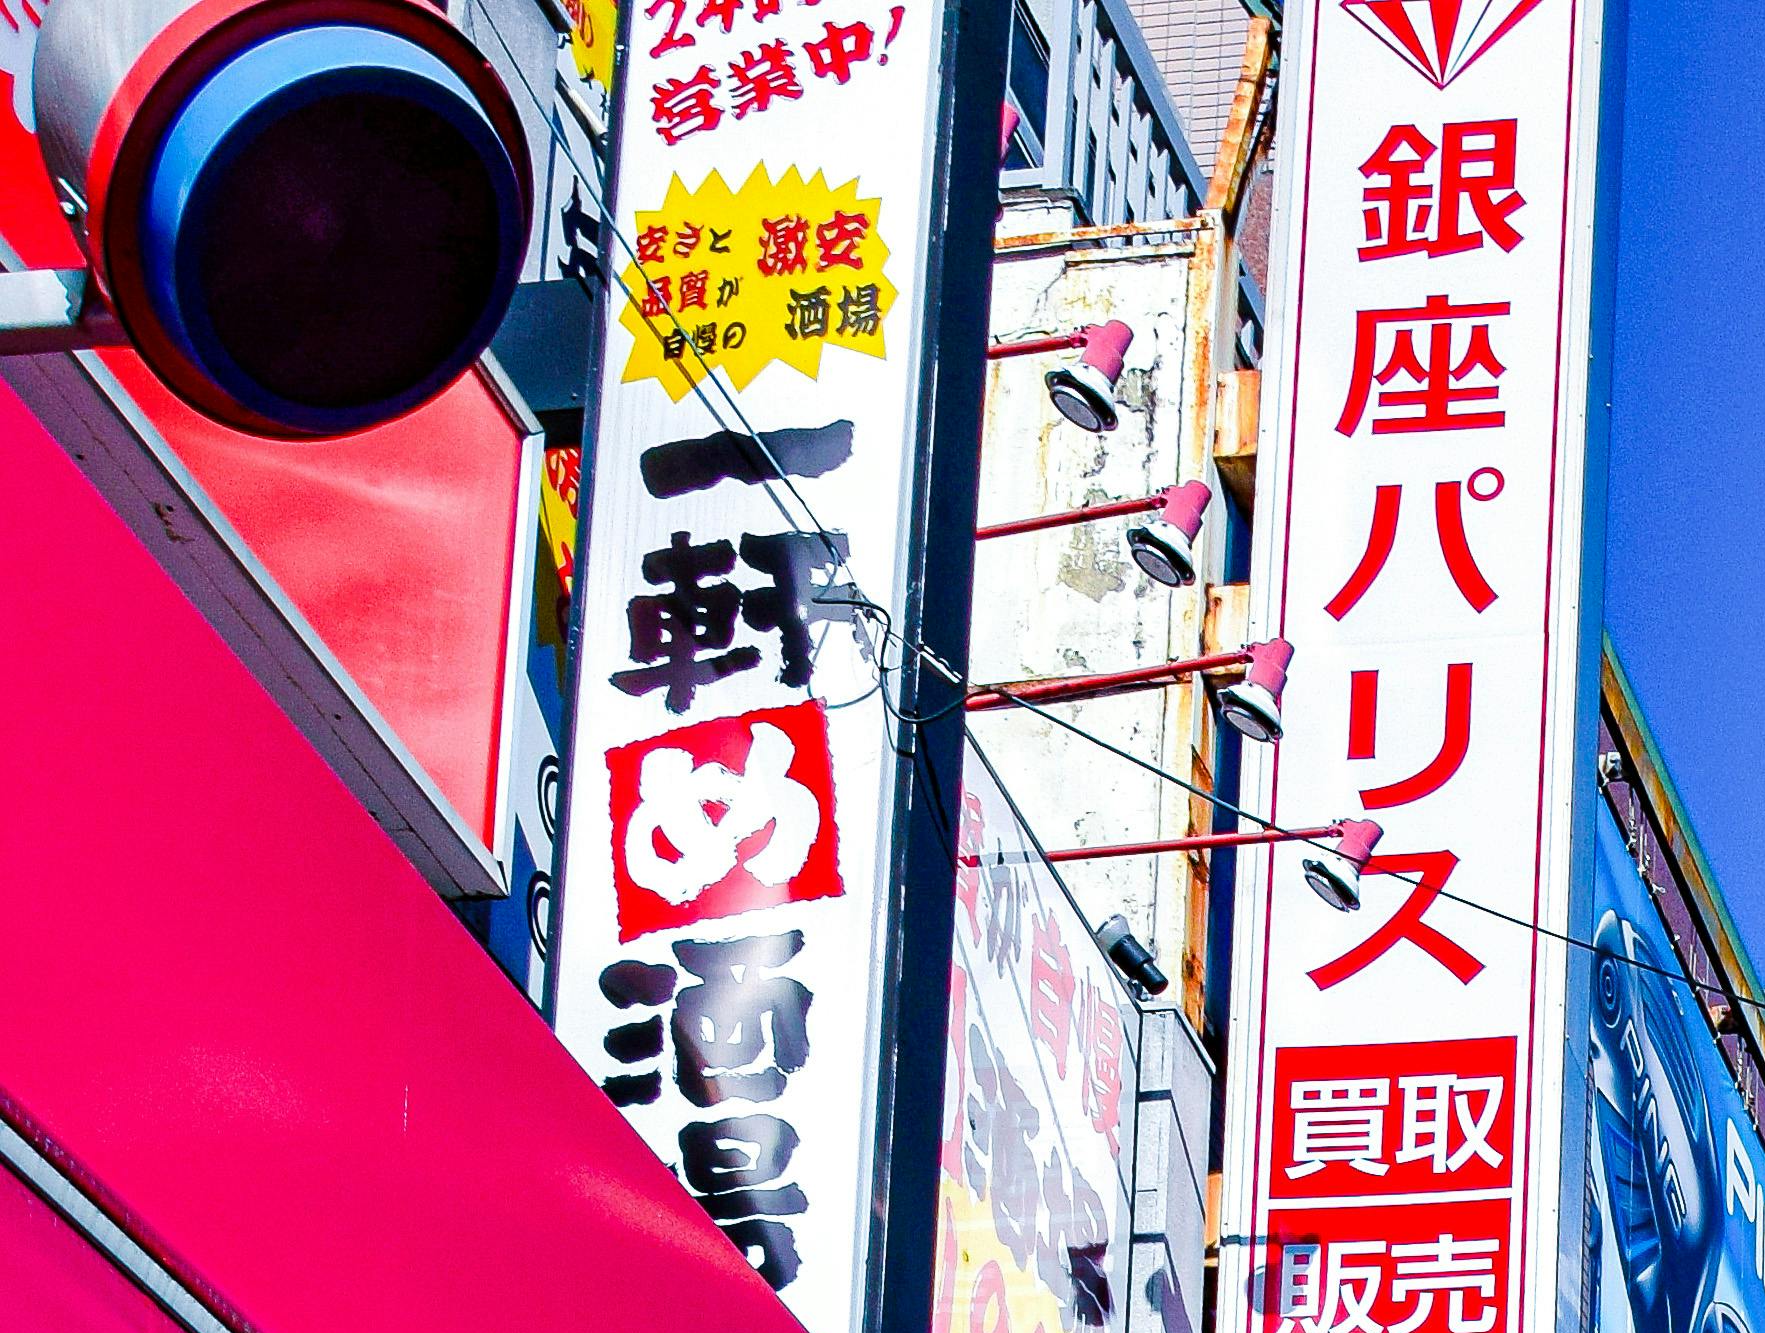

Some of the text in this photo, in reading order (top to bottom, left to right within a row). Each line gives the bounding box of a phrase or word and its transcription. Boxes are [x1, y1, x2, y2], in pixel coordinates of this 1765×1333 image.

[650, 5, 906, 146] 営業中!
[757, 210, 871, 277] 激安
[785, 283, 882, 341] 酒場
[1307, 119, 1527, 991] 銀座パリス
[1284, 1072, 1503, 1181] 買取
[1620, 1018, 1687, 1238] PING
